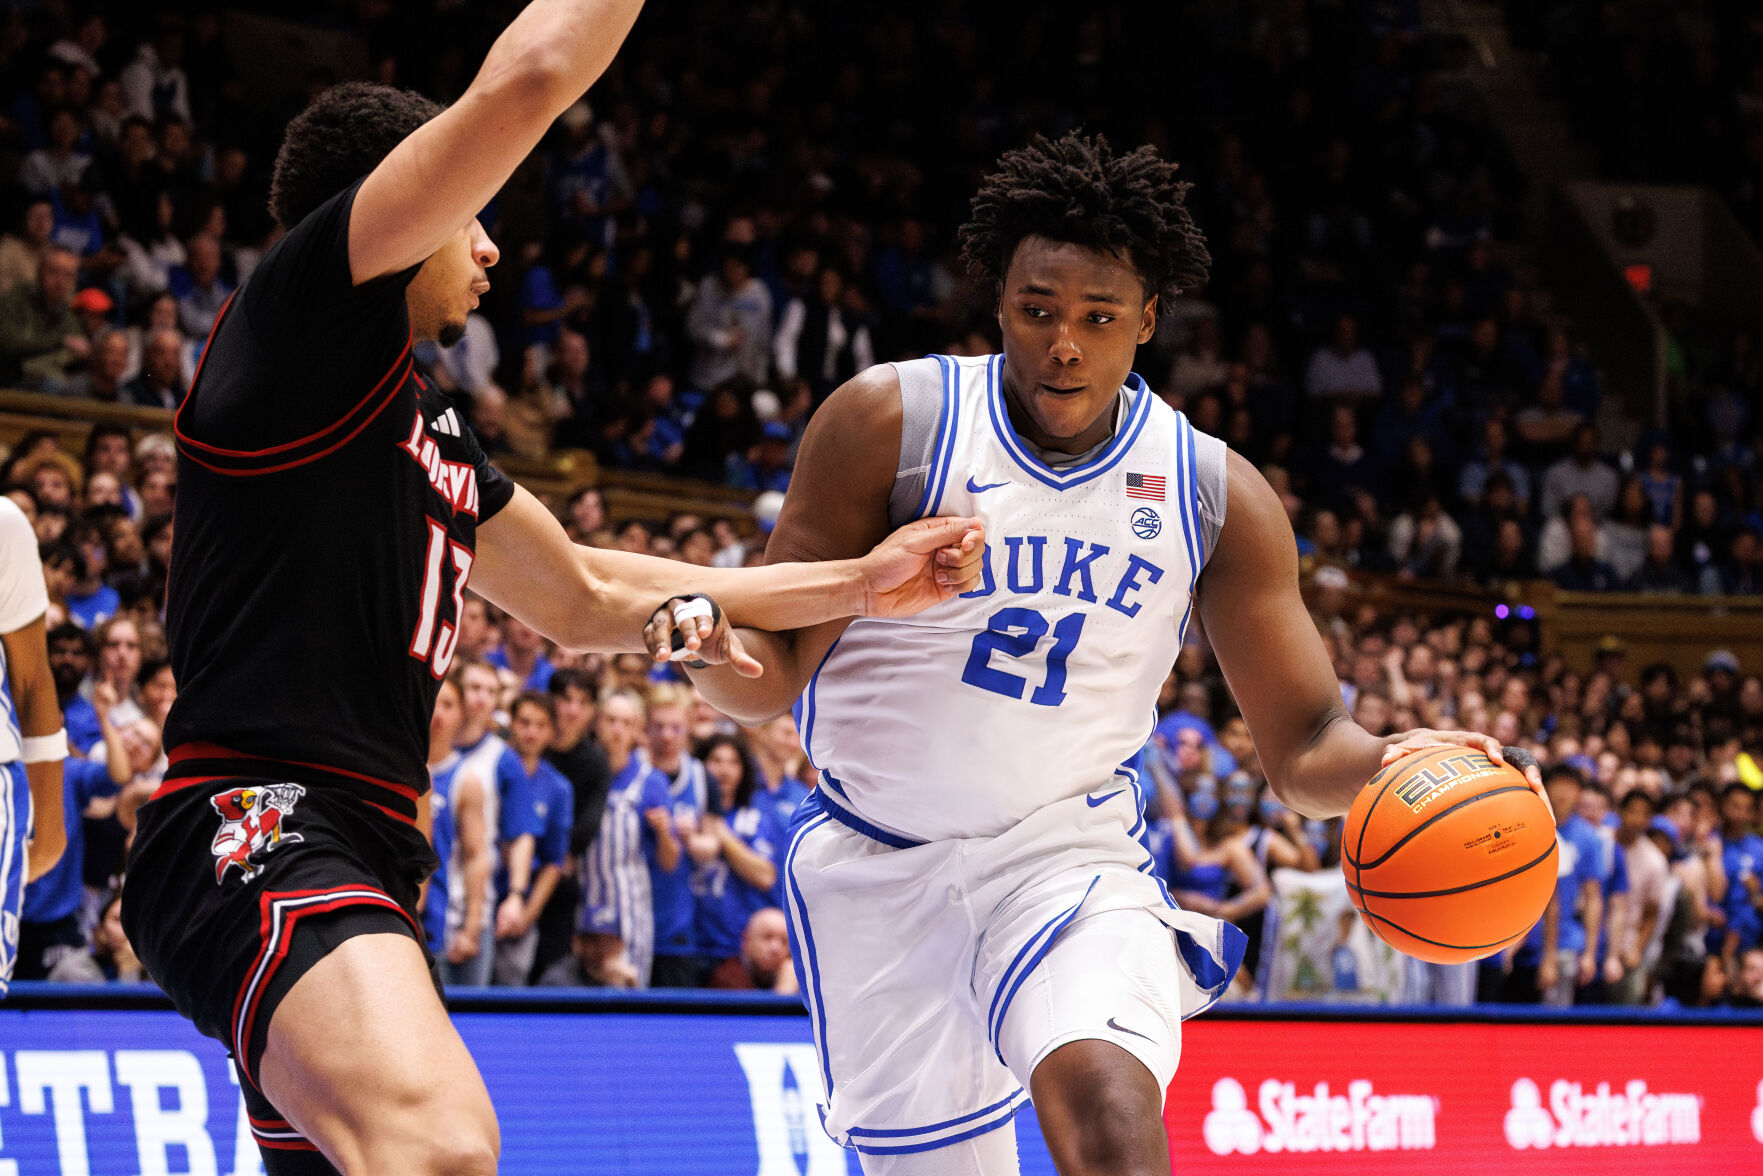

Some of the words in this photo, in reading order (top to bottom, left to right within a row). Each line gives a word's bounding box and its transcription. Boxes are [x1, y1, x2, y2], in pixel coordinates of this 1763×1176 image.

[1135, 517, 1160, 527] ACC
[409, 514, 475, 680] 13
[961, 607, 1087, 707] 21
[1394, 754, 1503, 807] ELITE
